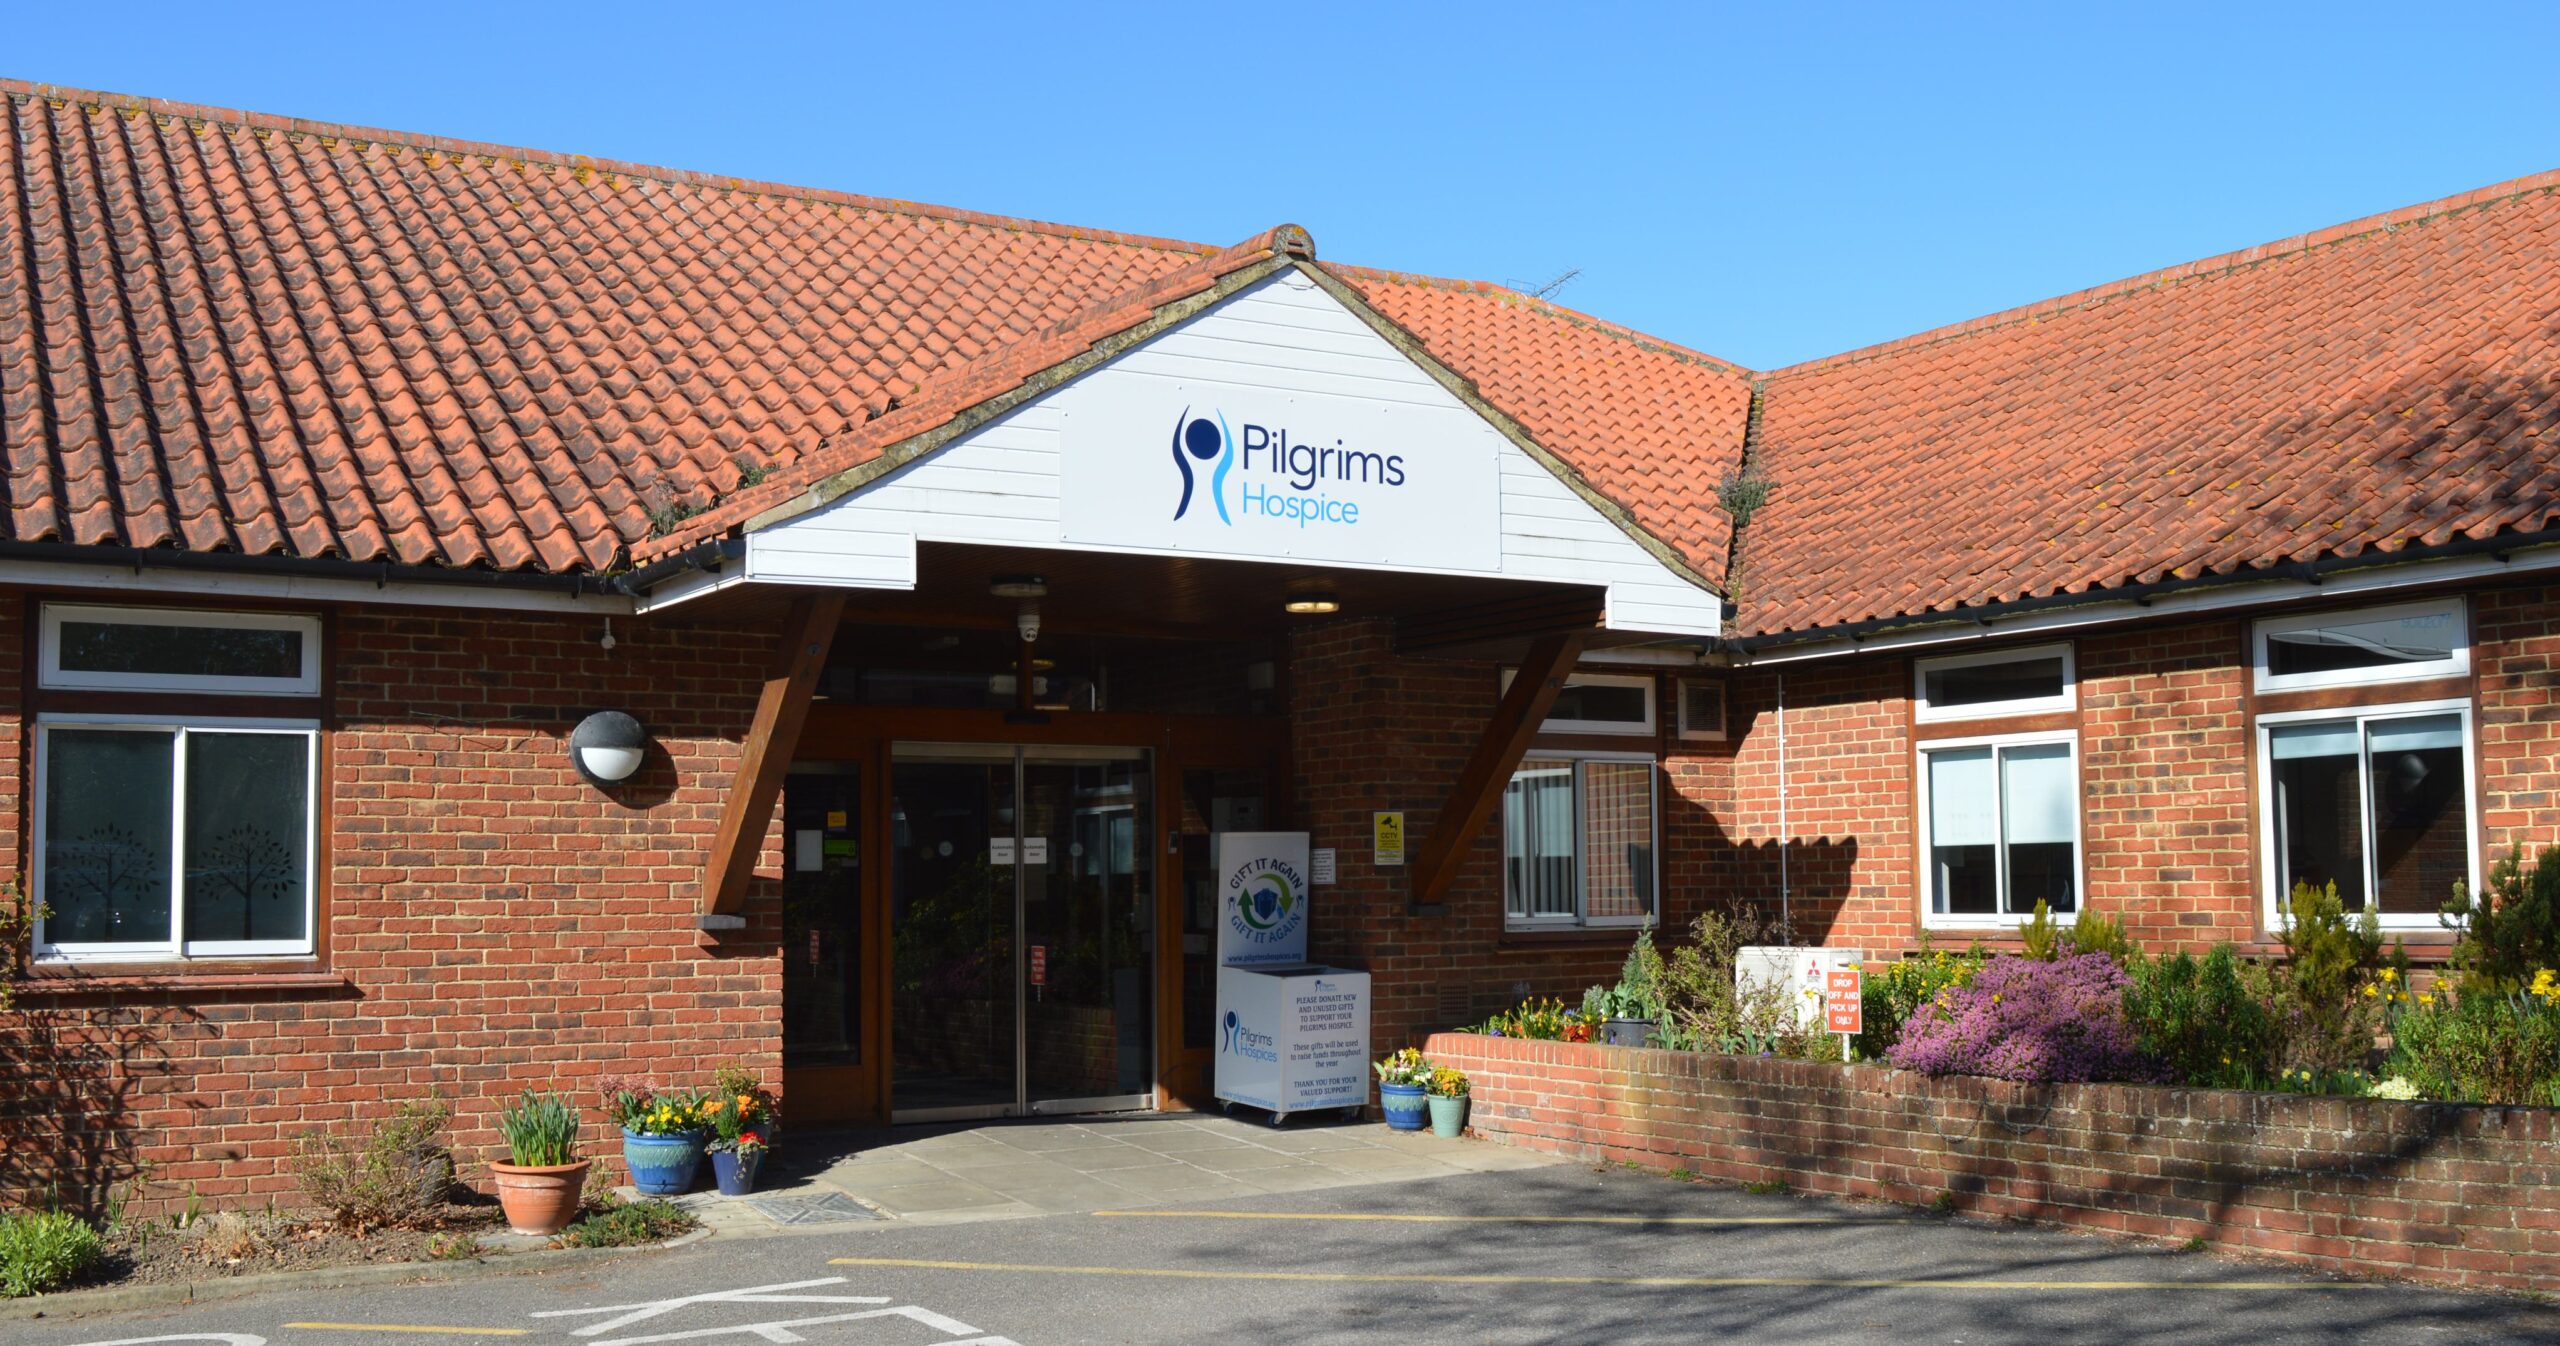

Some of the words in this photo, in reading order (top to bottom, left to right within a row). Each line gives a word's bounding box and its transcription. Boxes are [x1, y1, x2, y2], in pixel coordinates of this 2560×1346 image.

[1243, 423, 1405, 490] Pilgrims
[1243, 481, 1359, 528] Hospice
[1230, 862, 1253, 889] GIFT
[1255, 858, 1268, 870] IT
[1270, 858, 1304, 889] AGAIN
[1231, 915, 1253, 939] GIFT
[1254, 932, 1267, 944] IT
[1268, 912, 1302, 944] AGAIN
[1833, 979, 1853, 988] DROP
[1296, 996, 1318, 1004] PLEASE
[1319, 994, 1341, 1003] DONATE
[1344, 993, 1357, 1001] NEW
[1829, 991, 1842, 1000] OFF
[1844, 991, 1858, 1000] AND
[1313, 1004, 1337, 1012] UNUSED
[1338, 1003, 1354, 1011] GIFTS
[1830, 1003, 1845, 1012] PICK
[1847, 1004, 1857, 1012] UP
[1300, 1015, 1308, 1023] TO
[1310, 1013, 1336, 1022] SUPPORT
[1337, 1012, 1352, 1020] YOUR
[1835, 1015, 1853, 1025] ONLY
[1300, 1023, 1327, 1032] PILGRIMS
[1241, 1027, 1273, 1047] Pilgrims
[1293, 1043, 1309, 1051] These
[1311, 1042, 1323, 1051] gifts
[1336, 1040, 1344, 1048] be
[1345, 1039, 1359, 1047] used
[1240, 1042, 1278, 1063] Hospices
[1312, 1051, 1329, 1059] funds
[1315, 1060, 1324, 1068] the
[1325, 1060, 1338, 1068] year
[1341, 1076, 1357, 1084] YOUR
[1300, 1088, 1323, 1096] VALUED
